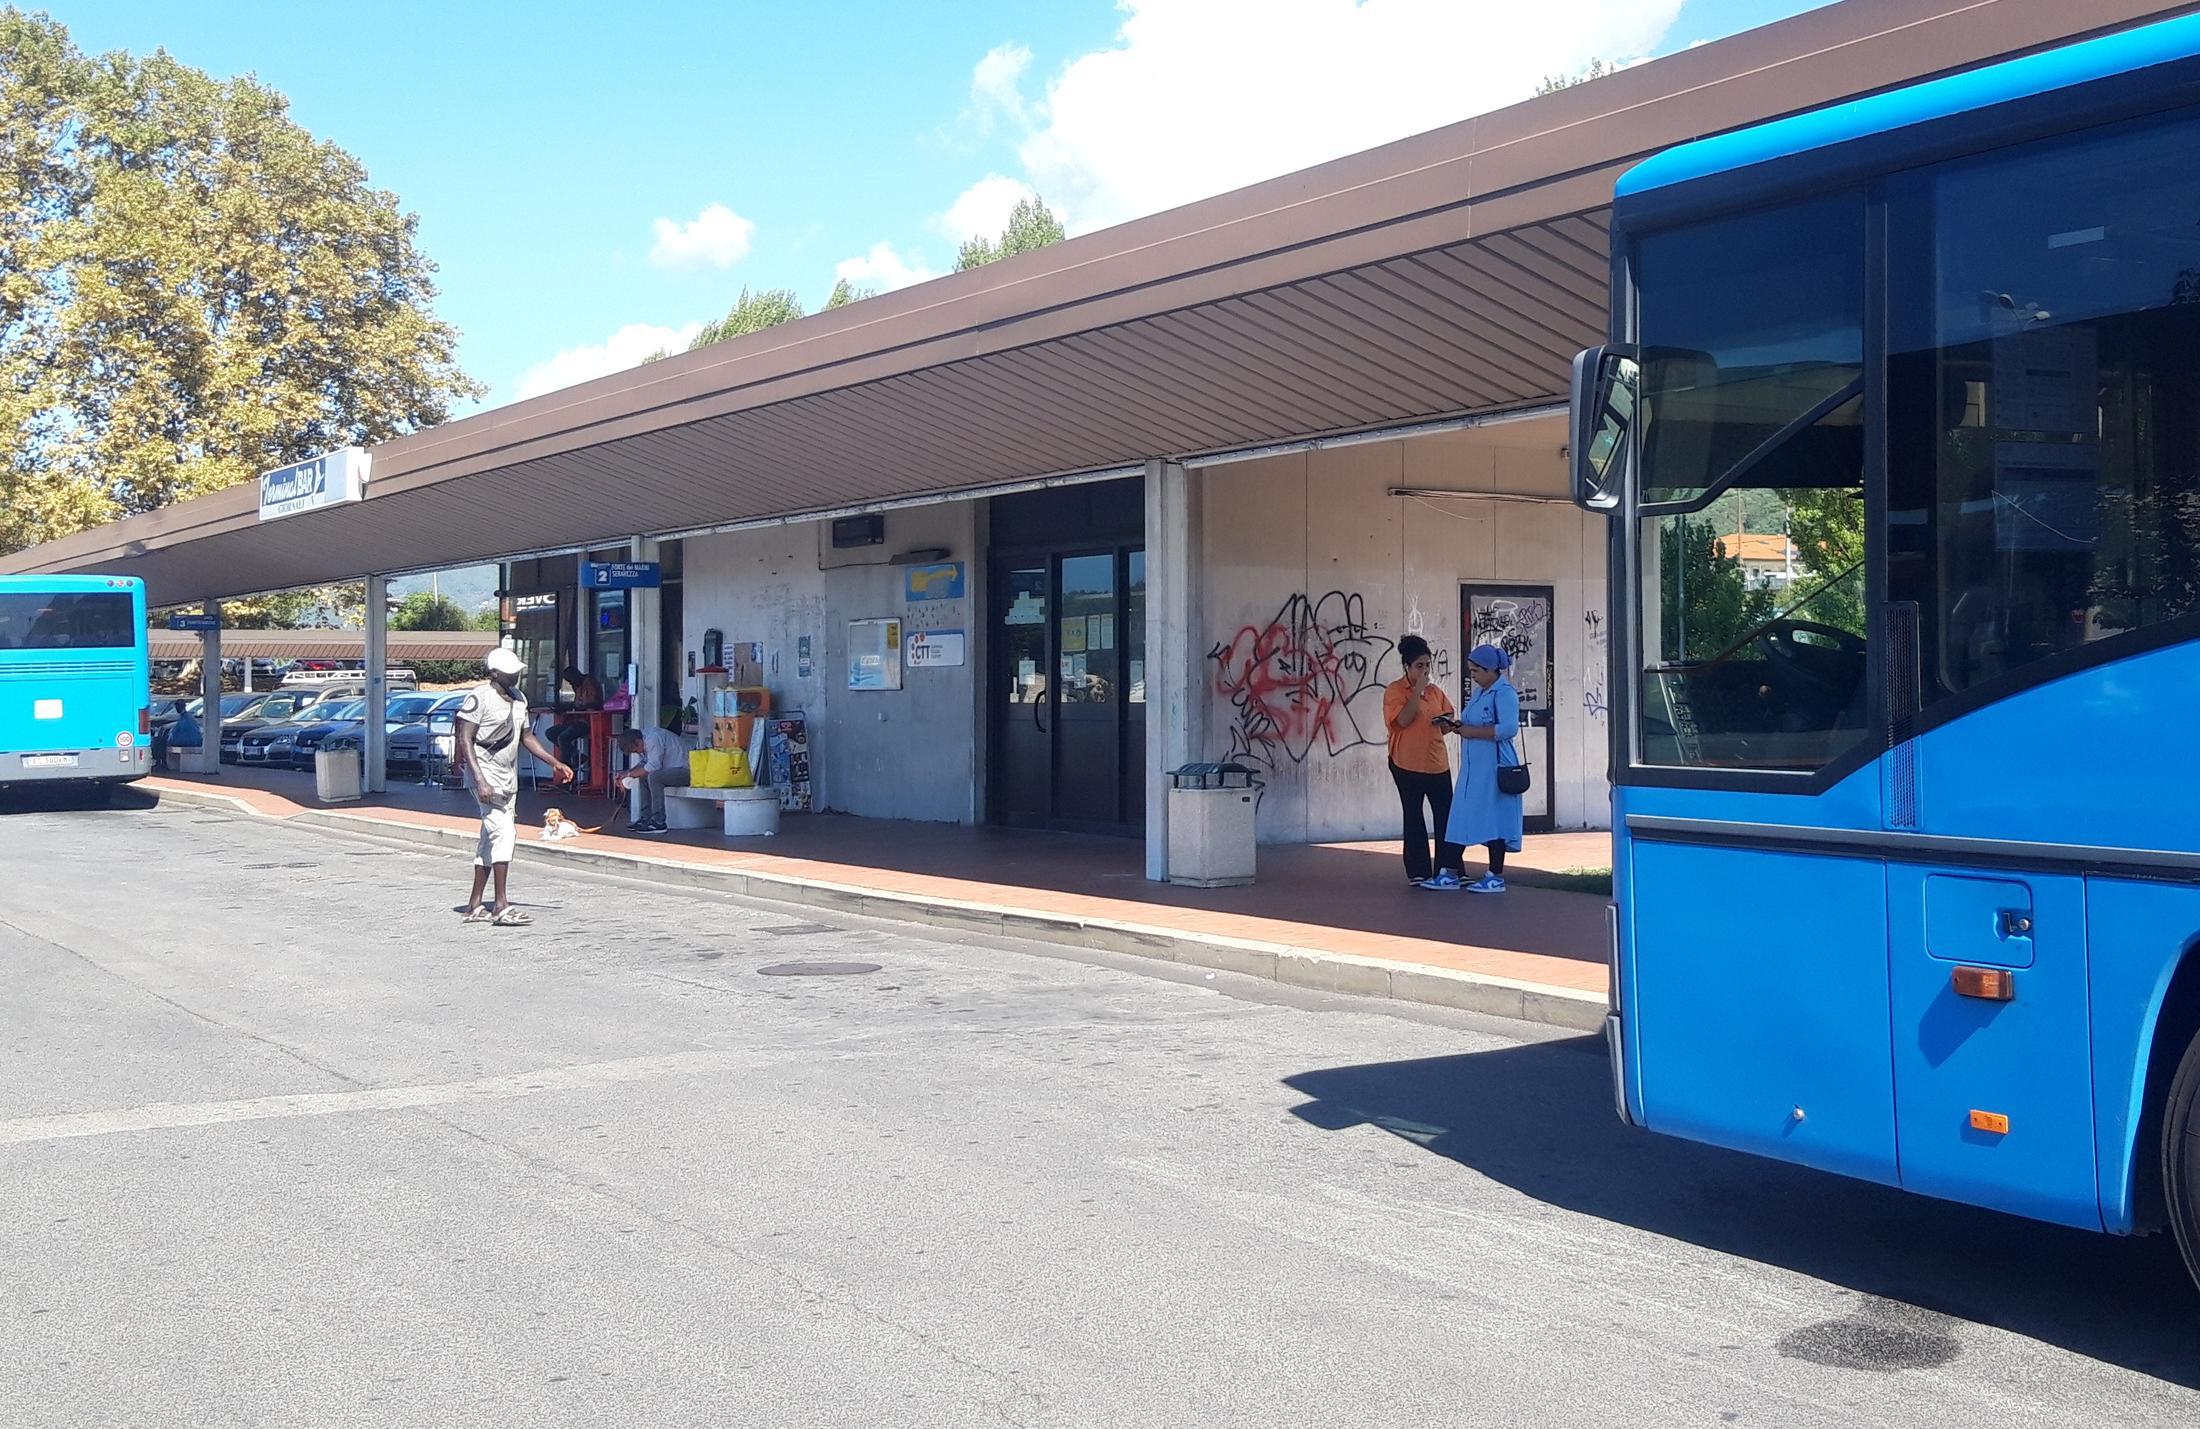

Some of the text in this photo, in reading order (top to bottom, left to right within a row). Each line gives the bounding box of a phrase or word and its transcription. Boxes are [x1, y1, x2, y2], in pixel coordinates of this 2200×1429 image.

[297, 467, 314, 496] BAR
[598, 570, 608, 582] 2
[179, 619, 186, 628] 3
[915, 644, 931, 660] CTT
